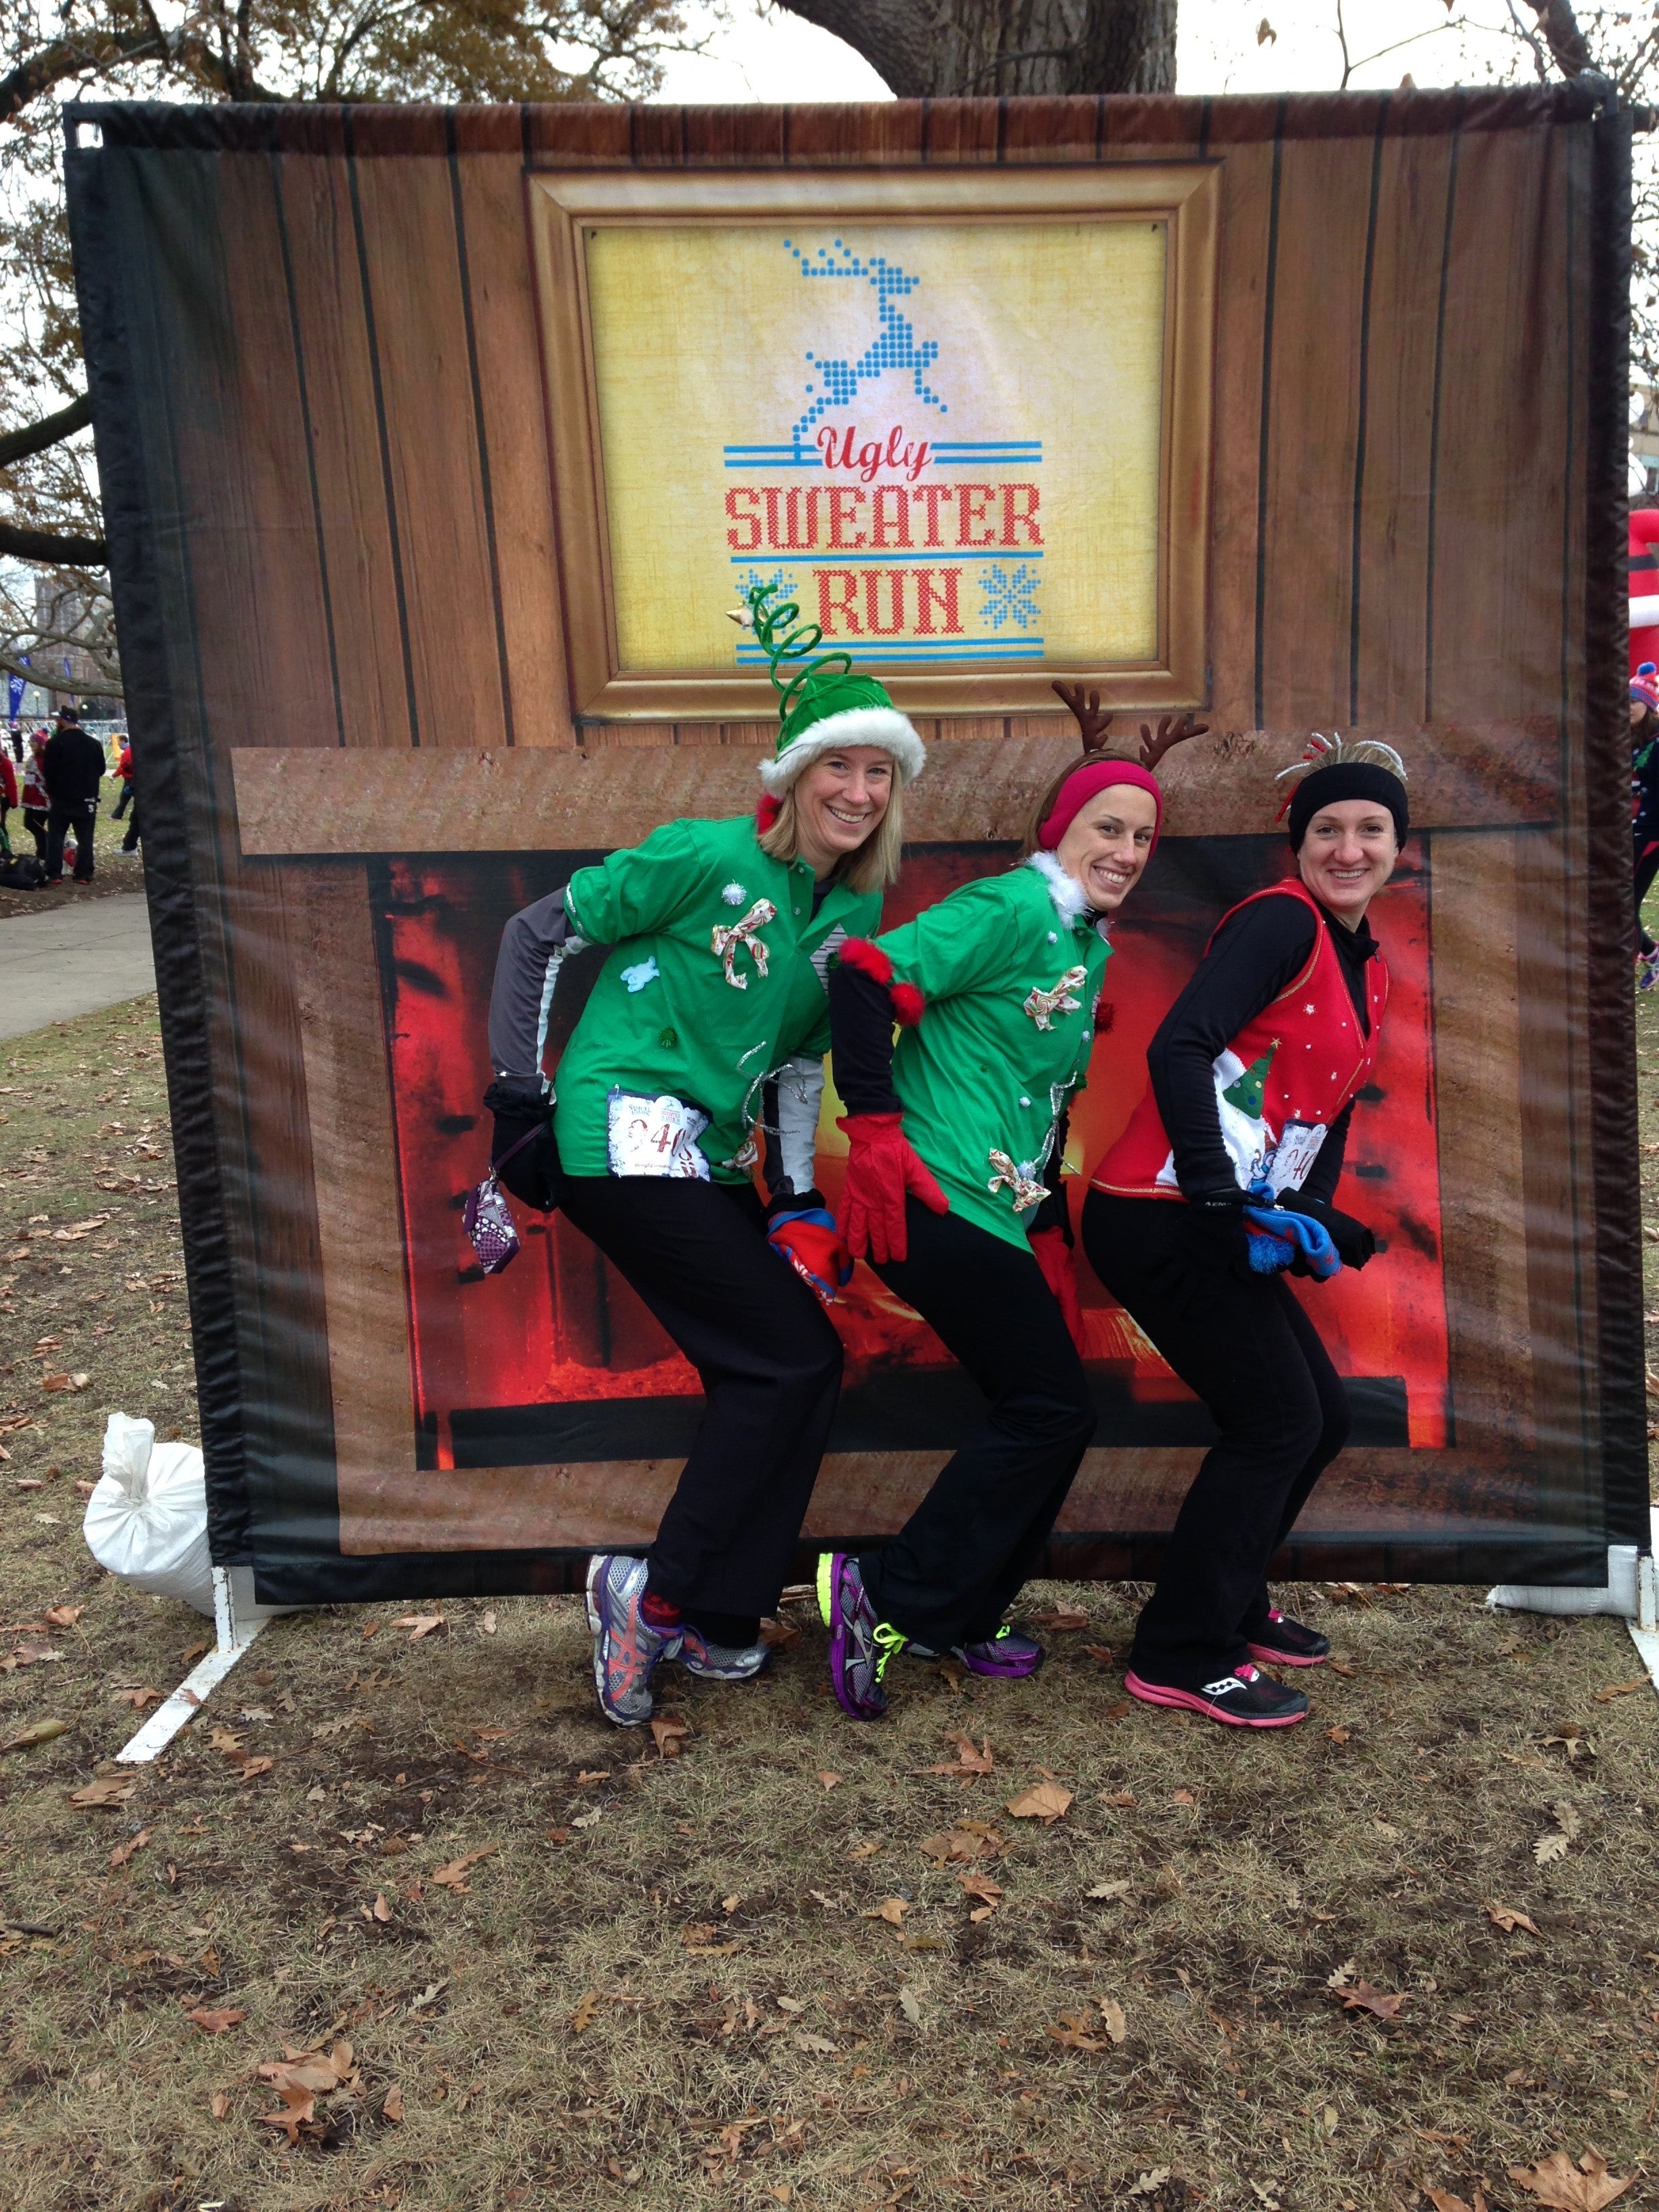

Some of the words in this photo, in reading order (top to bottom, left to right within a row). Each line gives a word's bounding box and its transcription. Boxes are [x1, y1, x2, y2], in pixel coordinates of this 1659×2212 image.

[817, 425, 932, 483] Ugly
[724, 483, 1046, 550] SWEATER
[812, 568, 964, 636] RUN
